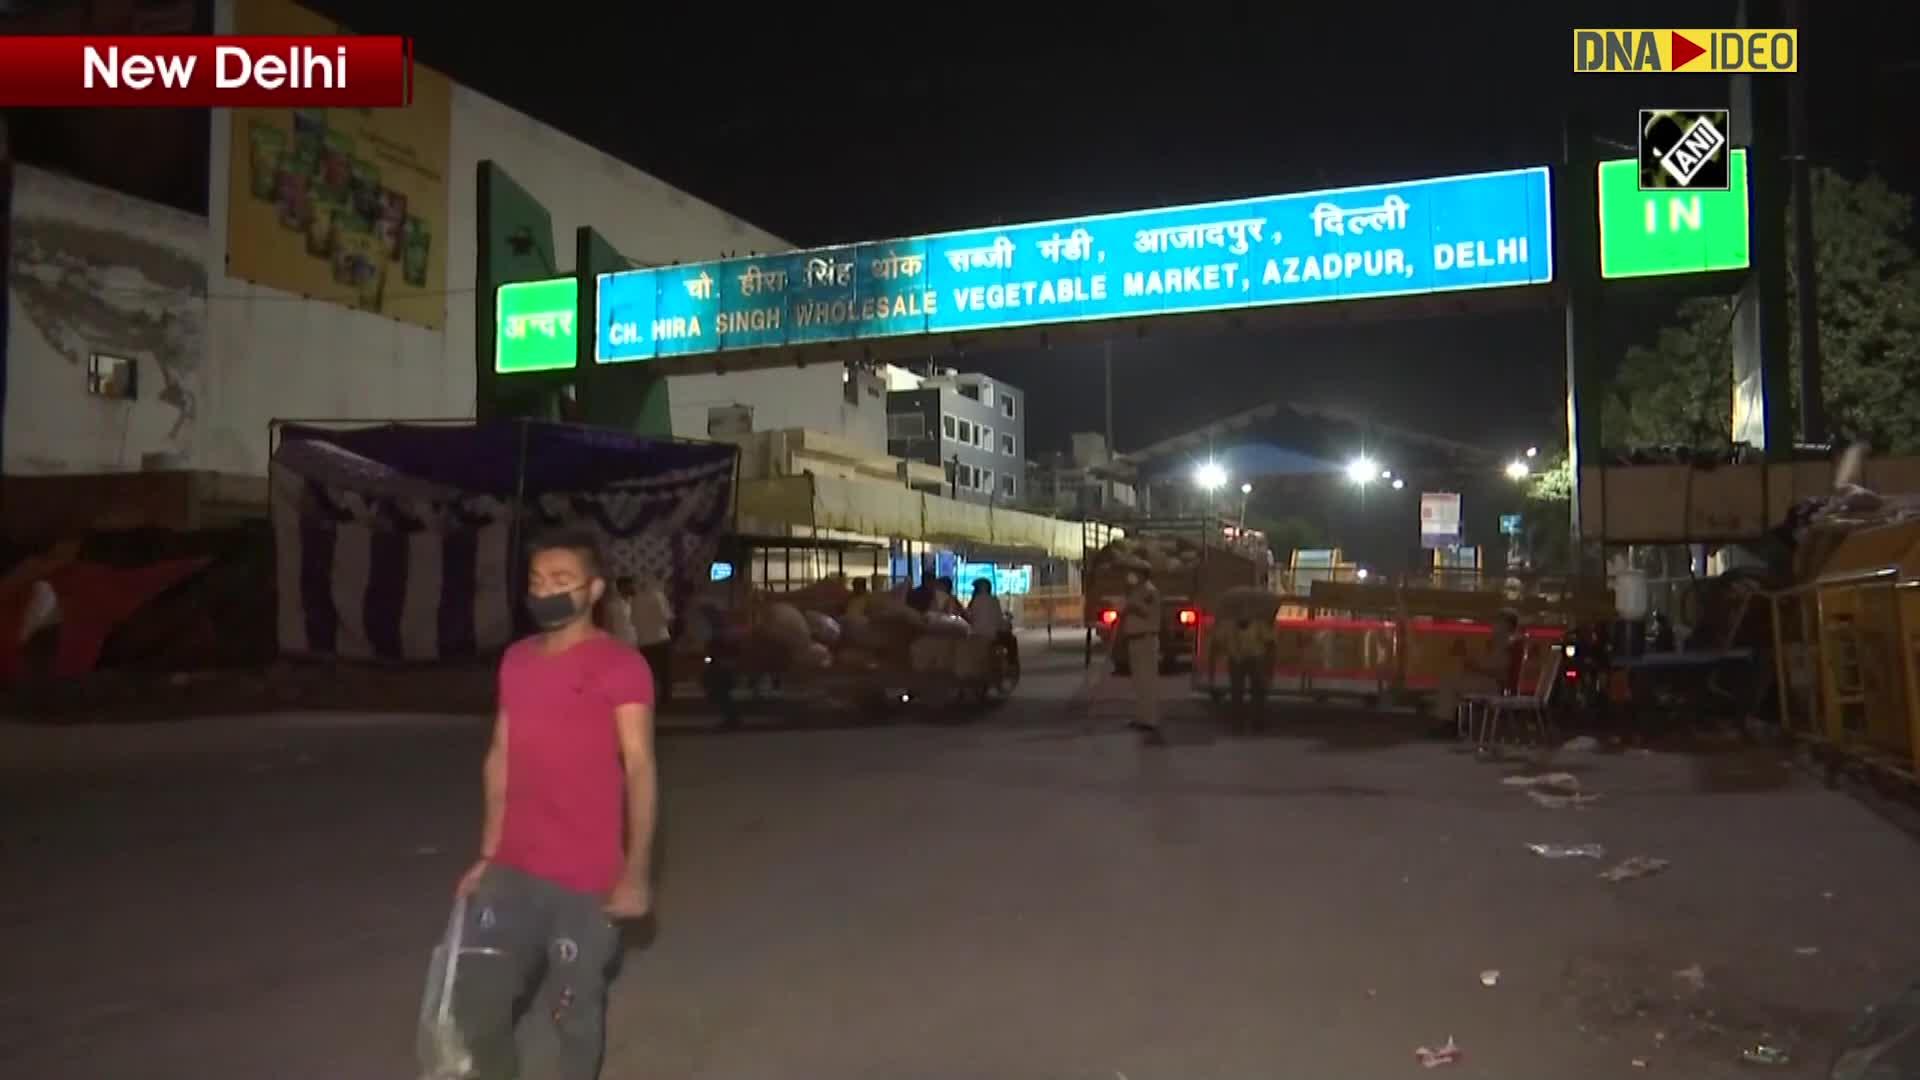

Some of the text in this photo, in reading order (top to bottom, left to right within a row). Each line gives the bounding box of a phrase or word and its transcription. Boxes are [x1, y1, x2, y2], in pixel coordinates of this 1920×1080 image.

[944, 235, 1016, 272] सब्जी
[1310, 194, 1410, 237] दिल्ली
[1644, 195, 1702, 235] IN
[608, 236, 1528, 346] CH. HIRA SINGH WHOLESALE VEGETABLE MARKET, AZADPUR, DELHI
